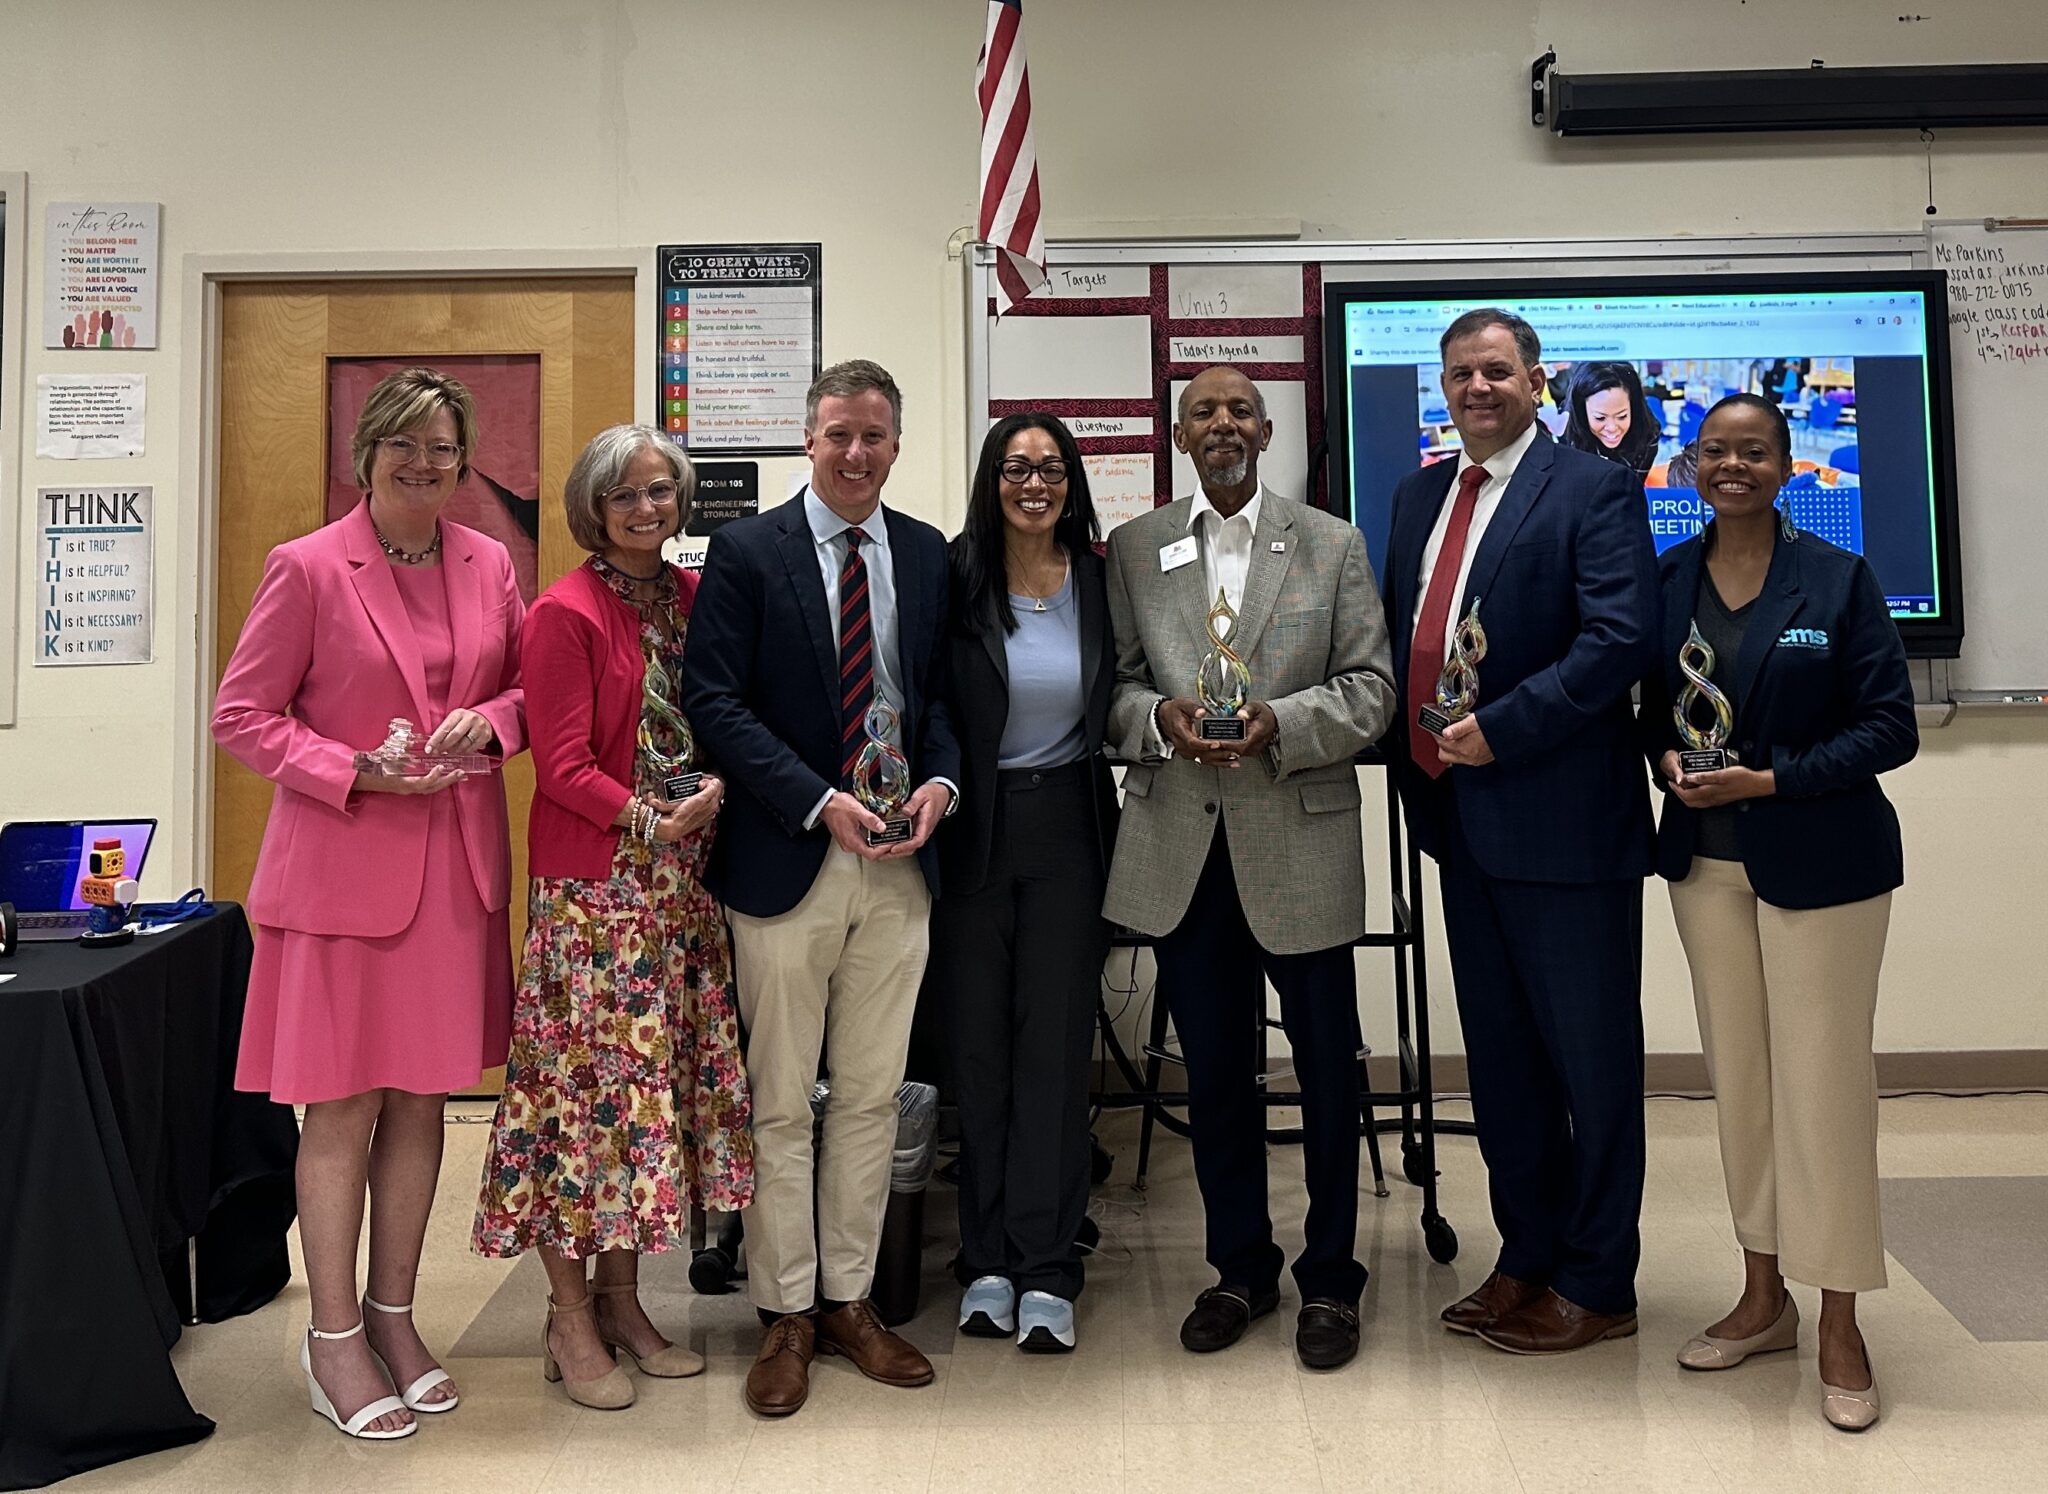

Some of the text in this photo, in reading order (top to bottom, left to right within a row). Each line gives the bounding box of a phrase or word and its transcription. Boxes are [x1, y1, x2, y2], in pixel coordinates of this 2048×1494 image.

[107, 212, 147, 234] Room
[688, 256, 791, 268] 10 GREAT WAYS
[678, 267, 801, 279] TO TREAT OTHERS
[1061, 270, 1108, 292] Targets
[674, 291, 681, 301] 1
[1178, 291, 1228, 317] Unit 3
[674, 307, 681, 317] 2
[712, 307, 730, 315] when
[731, 308, 743, 316] you
[1985, 307, 2017, 322] class
[674, 323, 680, 333] 3
[673, 337, 681, 349] 4
[761, 338, 777, 346] have
[1173, 342, 1259, 361] Today's Agenda
[673, 354, 681, 364] 5
[696, 355, 704, 363] Be
[673, 370, 681, 380] 6
[750, 370, 769, 379] speak
[673, 386, 680, 397] 7
[673, 402, 681, 412] 8
[712, 404, 727, 412] your
[673, 418, 680, 429] 9
[671, 435, 683, 444] 10
[728, 435, 743, 443] play
[700, 480, 727, 488] ROOM
[45, 492, 143, 525] THINK
[691, 500, 758, 509] RE-ENGINEERING
[703, 511, 741, 519] STORAGE
[47, 537, 116, 558] T is it TRUE?
[46, 560, 130, 582] H is it HELPFUL?
[64, 590, 73, 602] is
[76, 590, 84, 602] it
[87, 589, 136, 602] INSPIRING?
[45, 609, 143, 631] N is it NECESSARY?
[1779, 629, 1828, 645] cms
[45, 635, 114, 656] K is it KIND?
